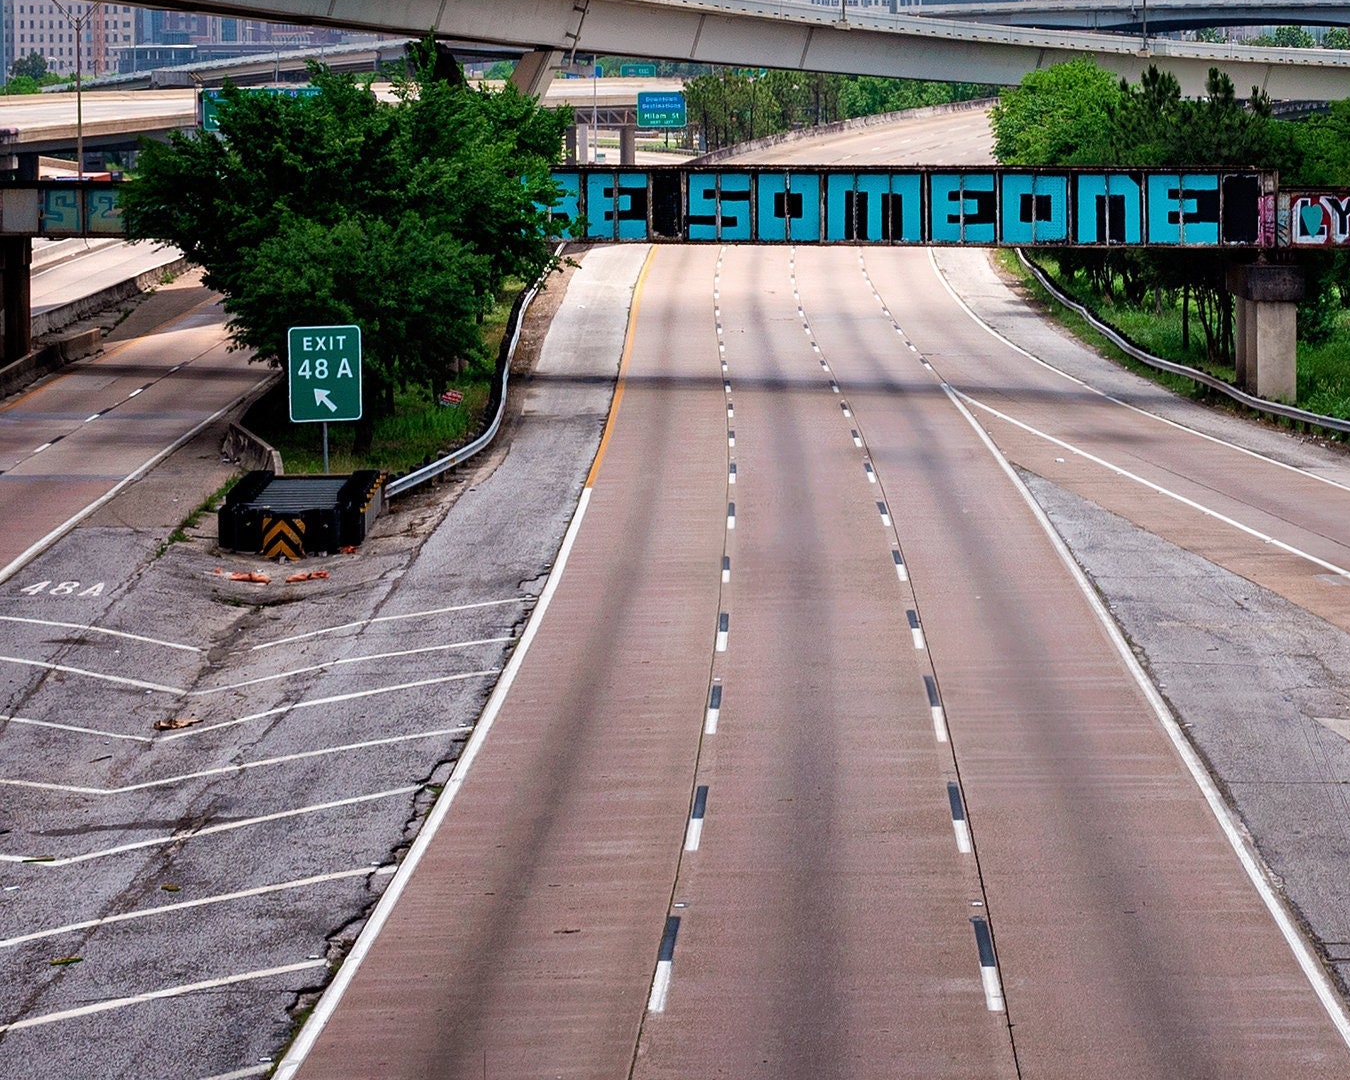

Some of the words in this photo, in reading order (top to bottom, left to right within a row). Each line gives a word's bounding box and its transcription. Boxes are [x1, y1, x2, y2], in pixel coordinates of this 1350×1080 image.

[688, 173, 1219, 243] SOMEONE
[303, 335, 346, 351] EXIT
[298, 358, 329, 380] 48
[336, 358, 353, 378] A
[20, 580, 105, 596] 48A
